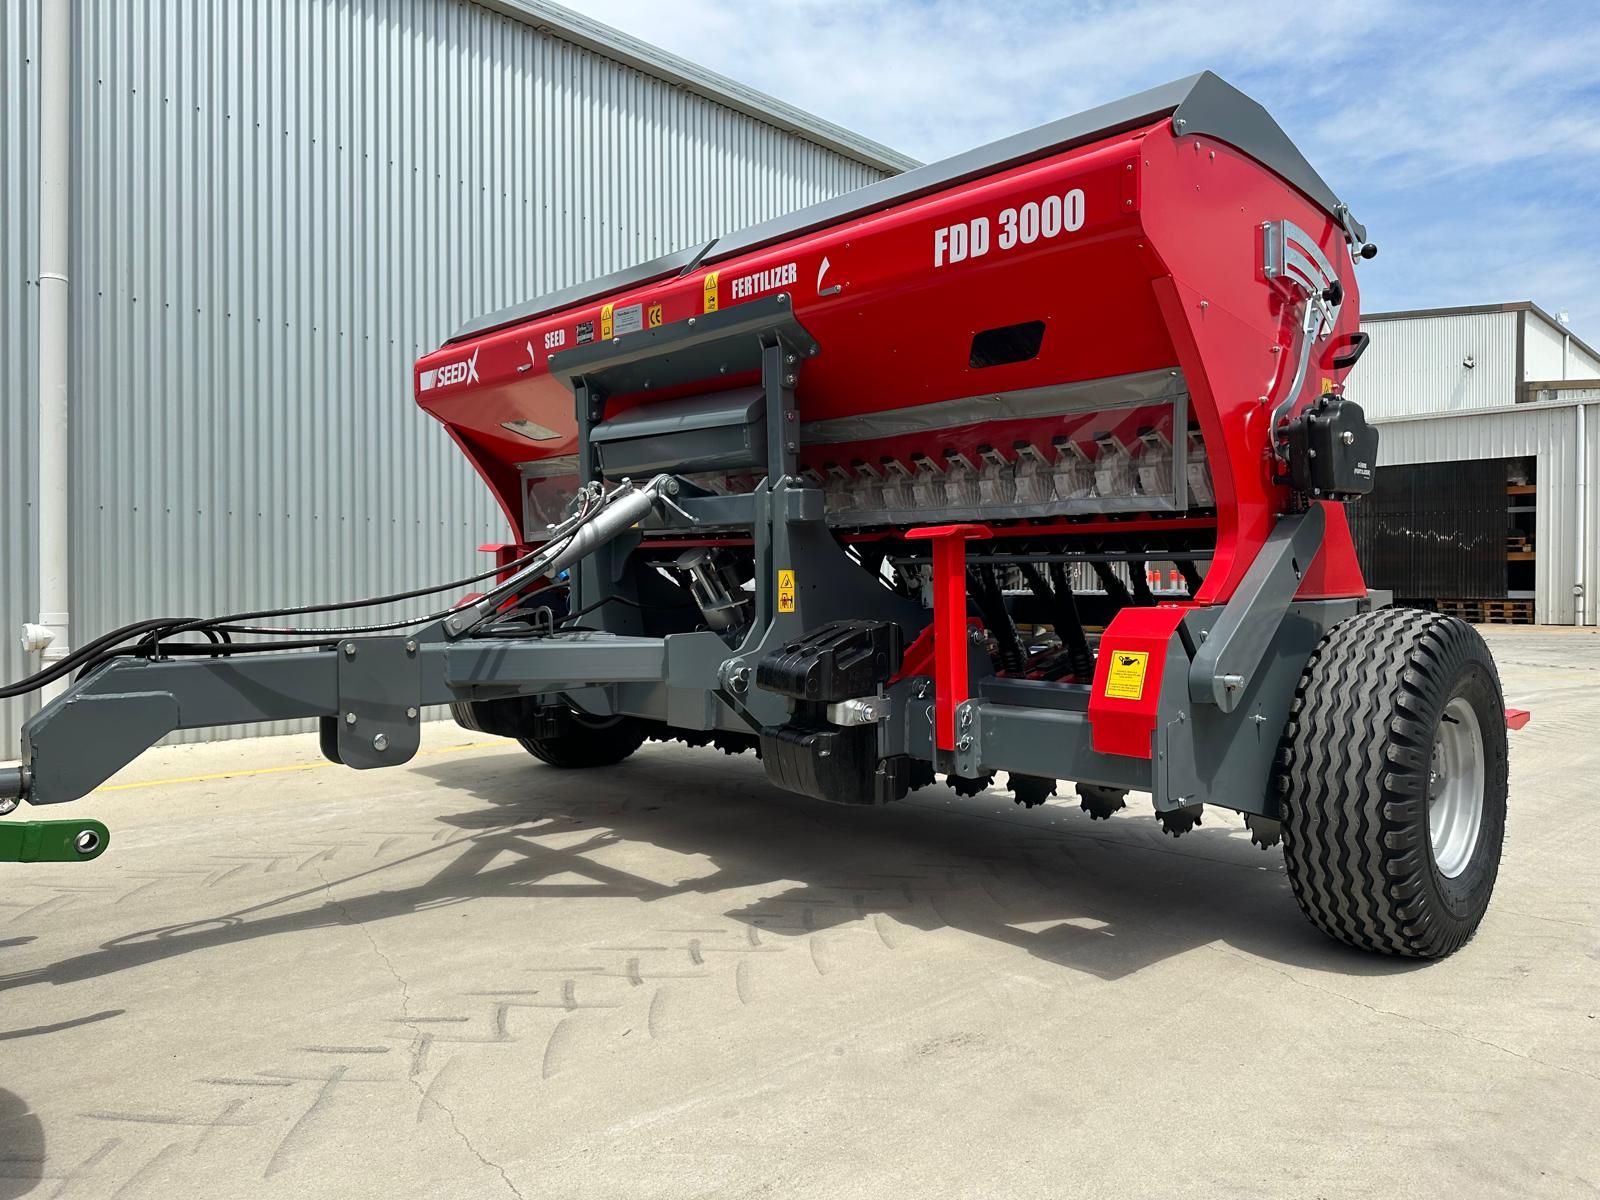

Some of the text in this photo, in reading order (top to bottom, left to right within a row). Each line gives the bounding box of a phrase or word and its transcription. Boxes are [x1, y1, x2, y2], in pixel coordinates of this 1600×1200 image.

[934, 188, 1085, 268] FDD 3000
[731, 262, 798, 300] FERTILIZER
[544, 329, 565, 350] SEED
